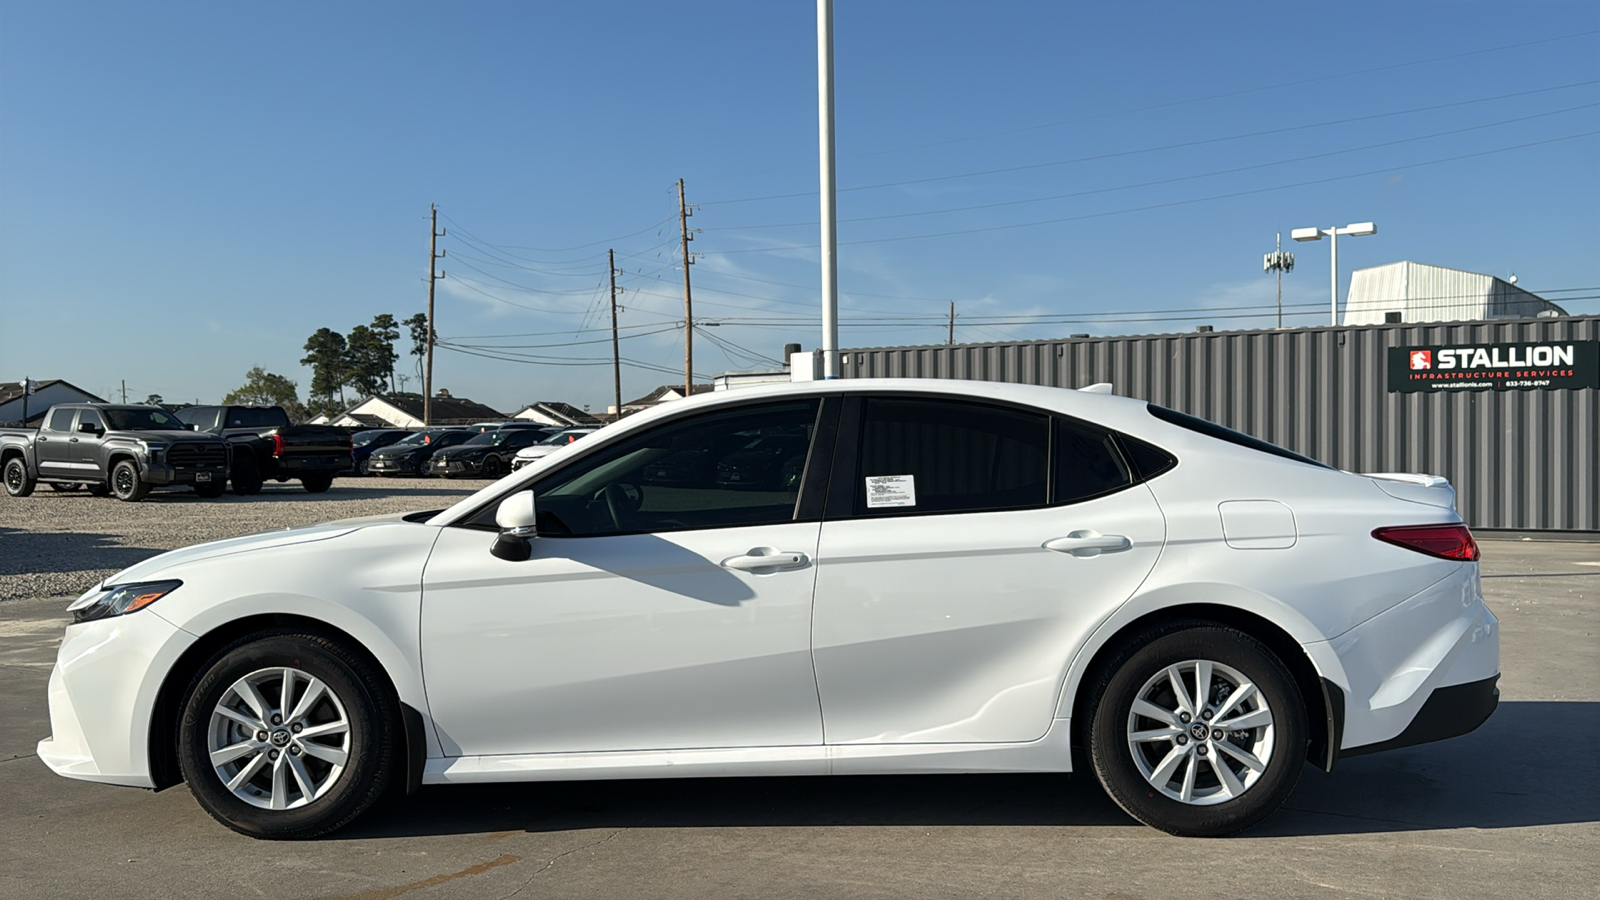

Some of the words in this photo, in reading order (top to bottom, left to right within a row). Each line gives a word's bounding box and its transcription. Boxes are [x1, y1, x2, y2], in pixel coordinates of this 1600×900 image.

[1437, 345, 1574, 369] STALLION
[1409, 371, 1510, 380] INFRASTRUCTURE
[1516, 369, 1574, 377] SERVICES
